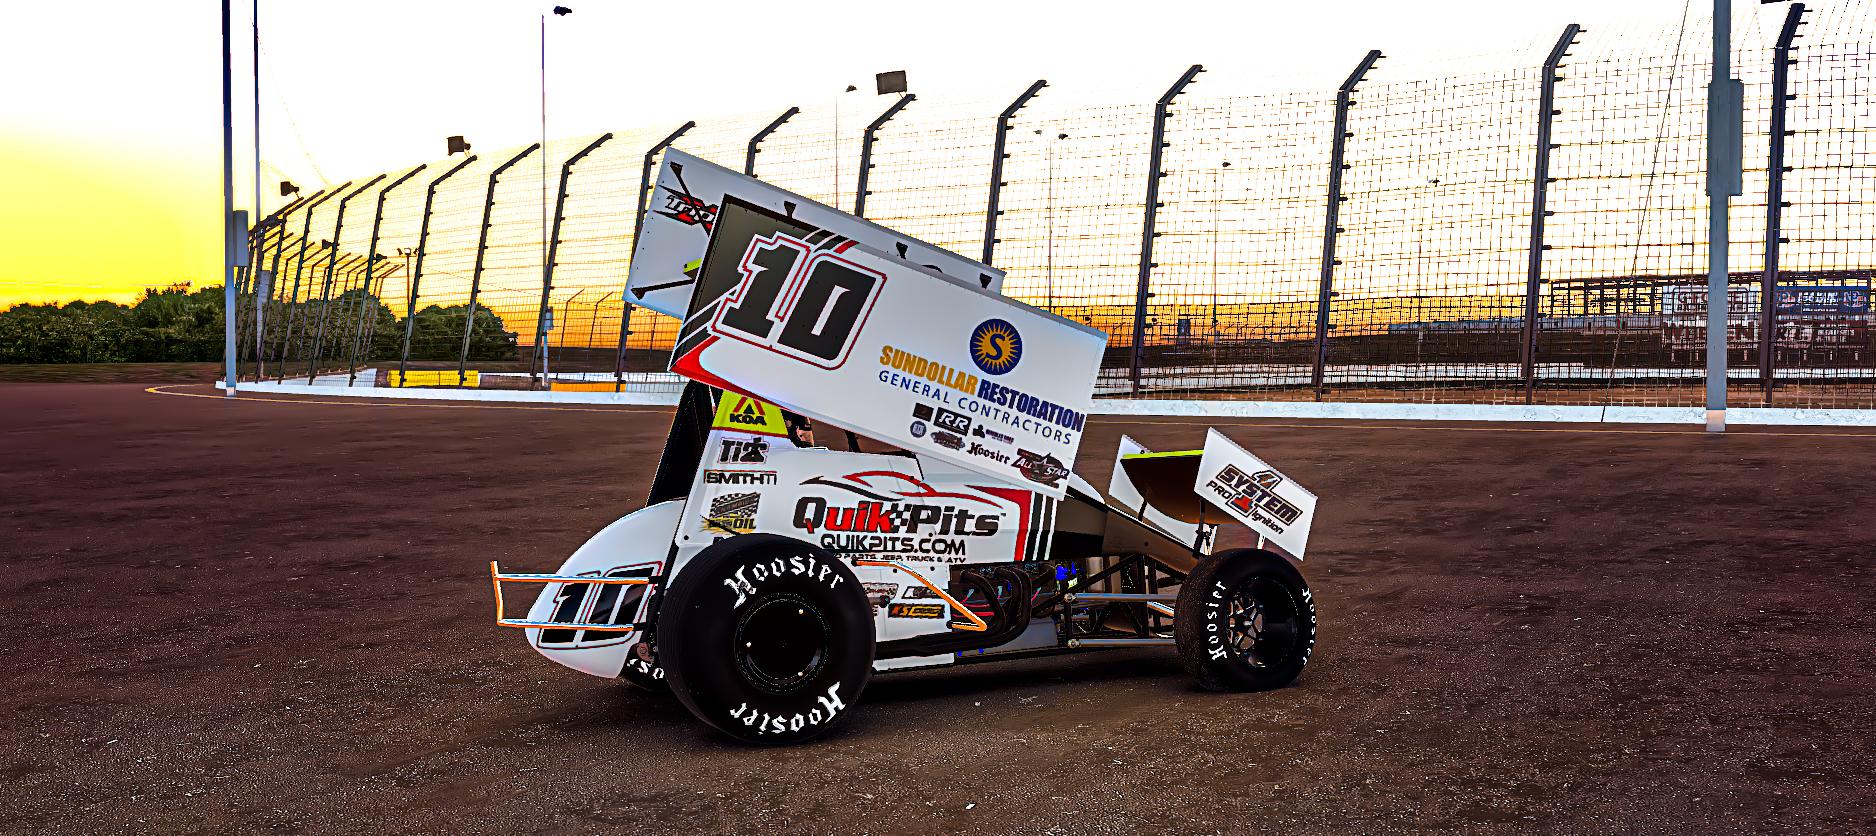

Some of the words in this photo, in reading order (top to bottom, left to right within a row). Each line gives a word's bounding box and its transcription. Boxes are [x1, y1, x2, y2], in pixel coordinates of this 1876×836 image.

[716, 238, 881, 364] 10
[878, 370, 950, 404] GENERAL
[957, 397, 1072, 445] CONTRACTORS
[879, 344, 979, 395] SUNDOLLAR
[977, 378, 1086, 433] RESTORATION
[729, 413, 767, 426] KOA
[966, 442, 1011, 465] Hoosier
[1044, 466, 1068, 477] STAR
[1206, 480, 1232, 499] PRO
[1251, 510, 1284, 534] Ignition
[1218, 466, 1300, 522] SYSTEM
[733, 518, 757, 529] OIL
[821, 534, 966, 557] QUIKPITS.COM
[540, 566, 655, 643] 10
[724, 553, 844, 608] Hoosier
[1206, 581, 1227, 661] Hoosier
[730, 680, 846, 735] Hoosier
